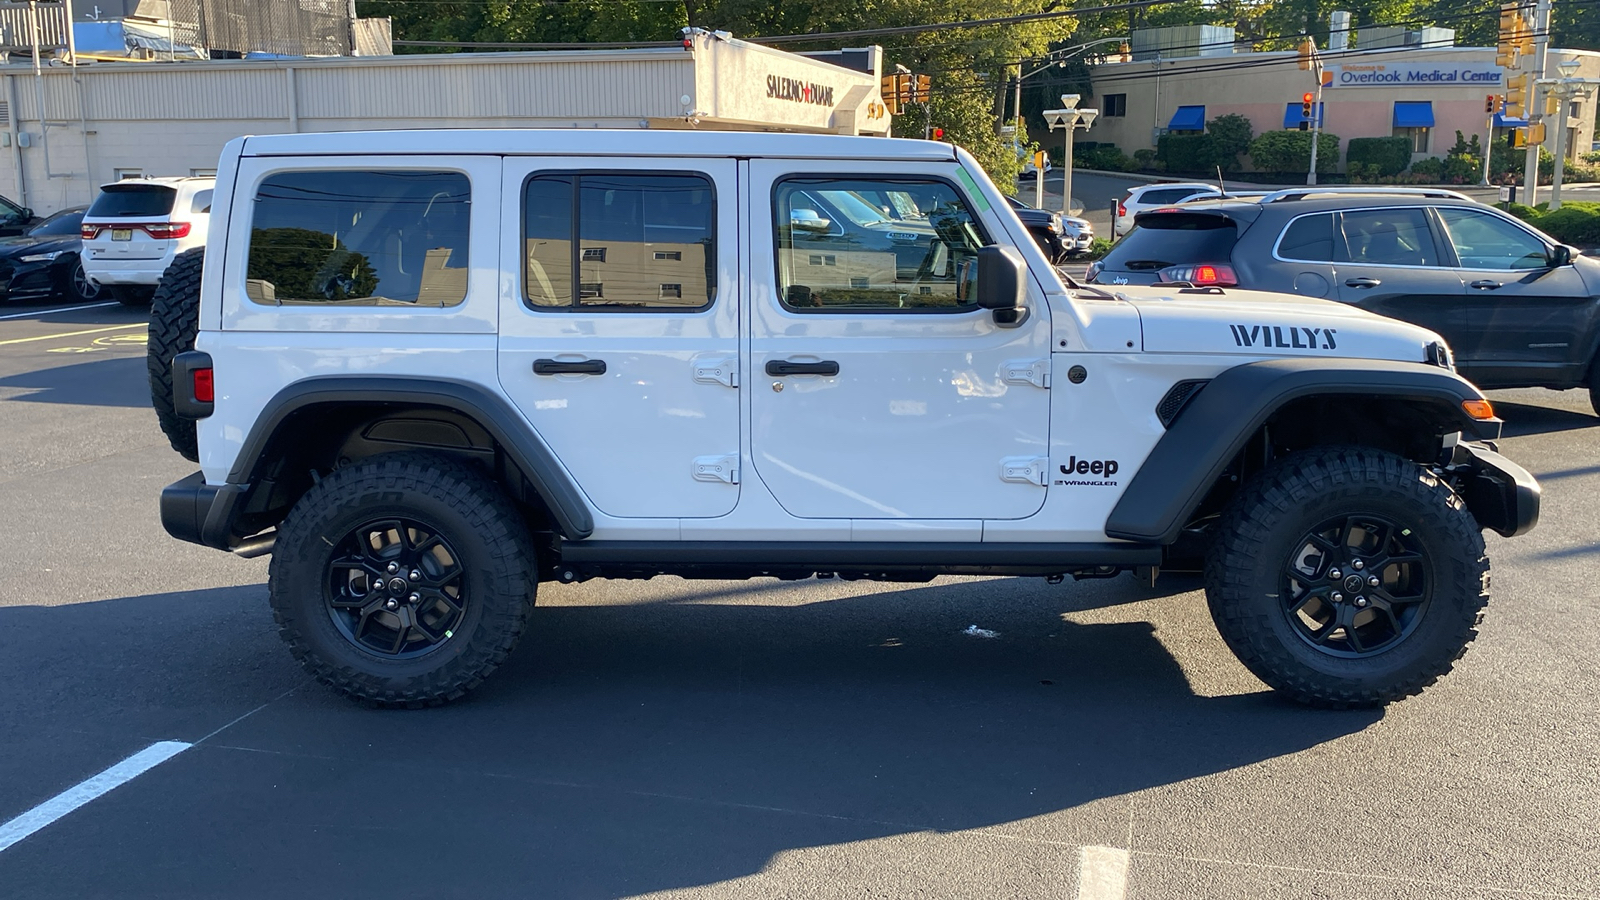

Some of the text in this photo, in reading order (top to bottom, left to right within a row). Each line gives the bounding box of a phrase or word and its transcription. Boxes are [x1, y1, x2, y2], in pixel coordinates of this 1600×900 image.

[1341, 70, 1502, 83] Overlook Medical Center
[766, 74, 834, 107] SALERNO DUANE
[1229, 324, 1337, 350] WILLYS
[1060, 455, 1118, 478] Jeep
